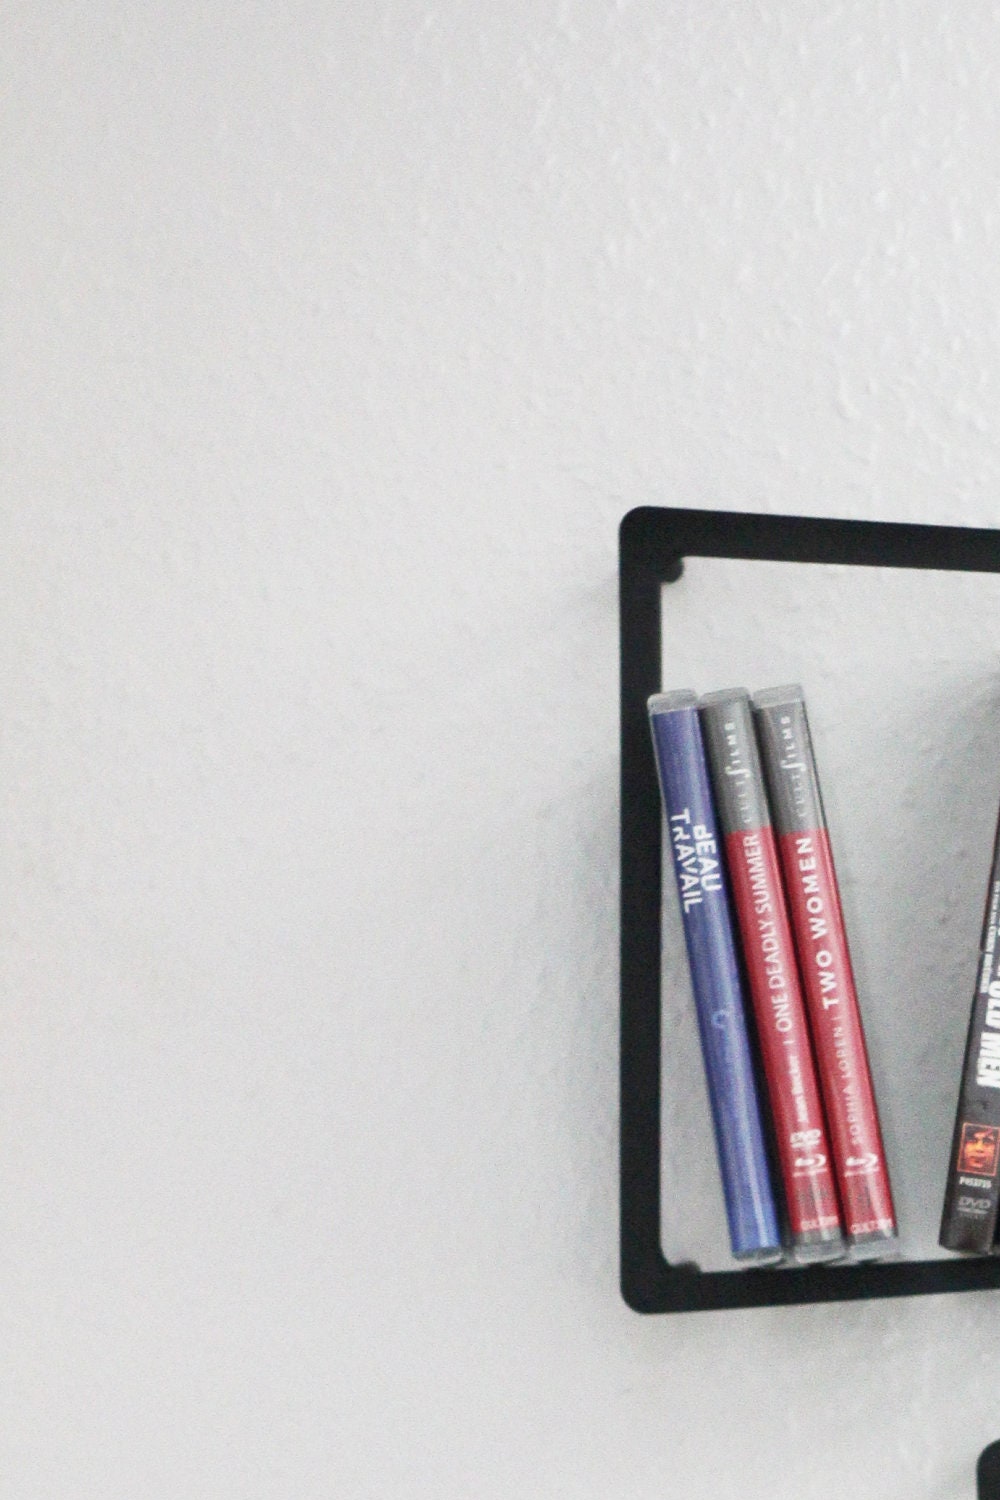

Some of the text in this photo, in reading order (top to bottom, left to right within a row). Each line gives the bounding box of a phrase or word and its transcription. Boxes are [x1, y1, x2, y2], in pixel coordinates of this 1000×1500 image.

[670, 807, 703, 914] TRAVAIL
[742, 833, 774, 915] SUMMER
[795, 837, 829, 940] WOMEN
[757, 917, 787, 990] DEADLY
[815, 949, 841, 1011] TWO
[770, 992, 793, 1033] ONE
